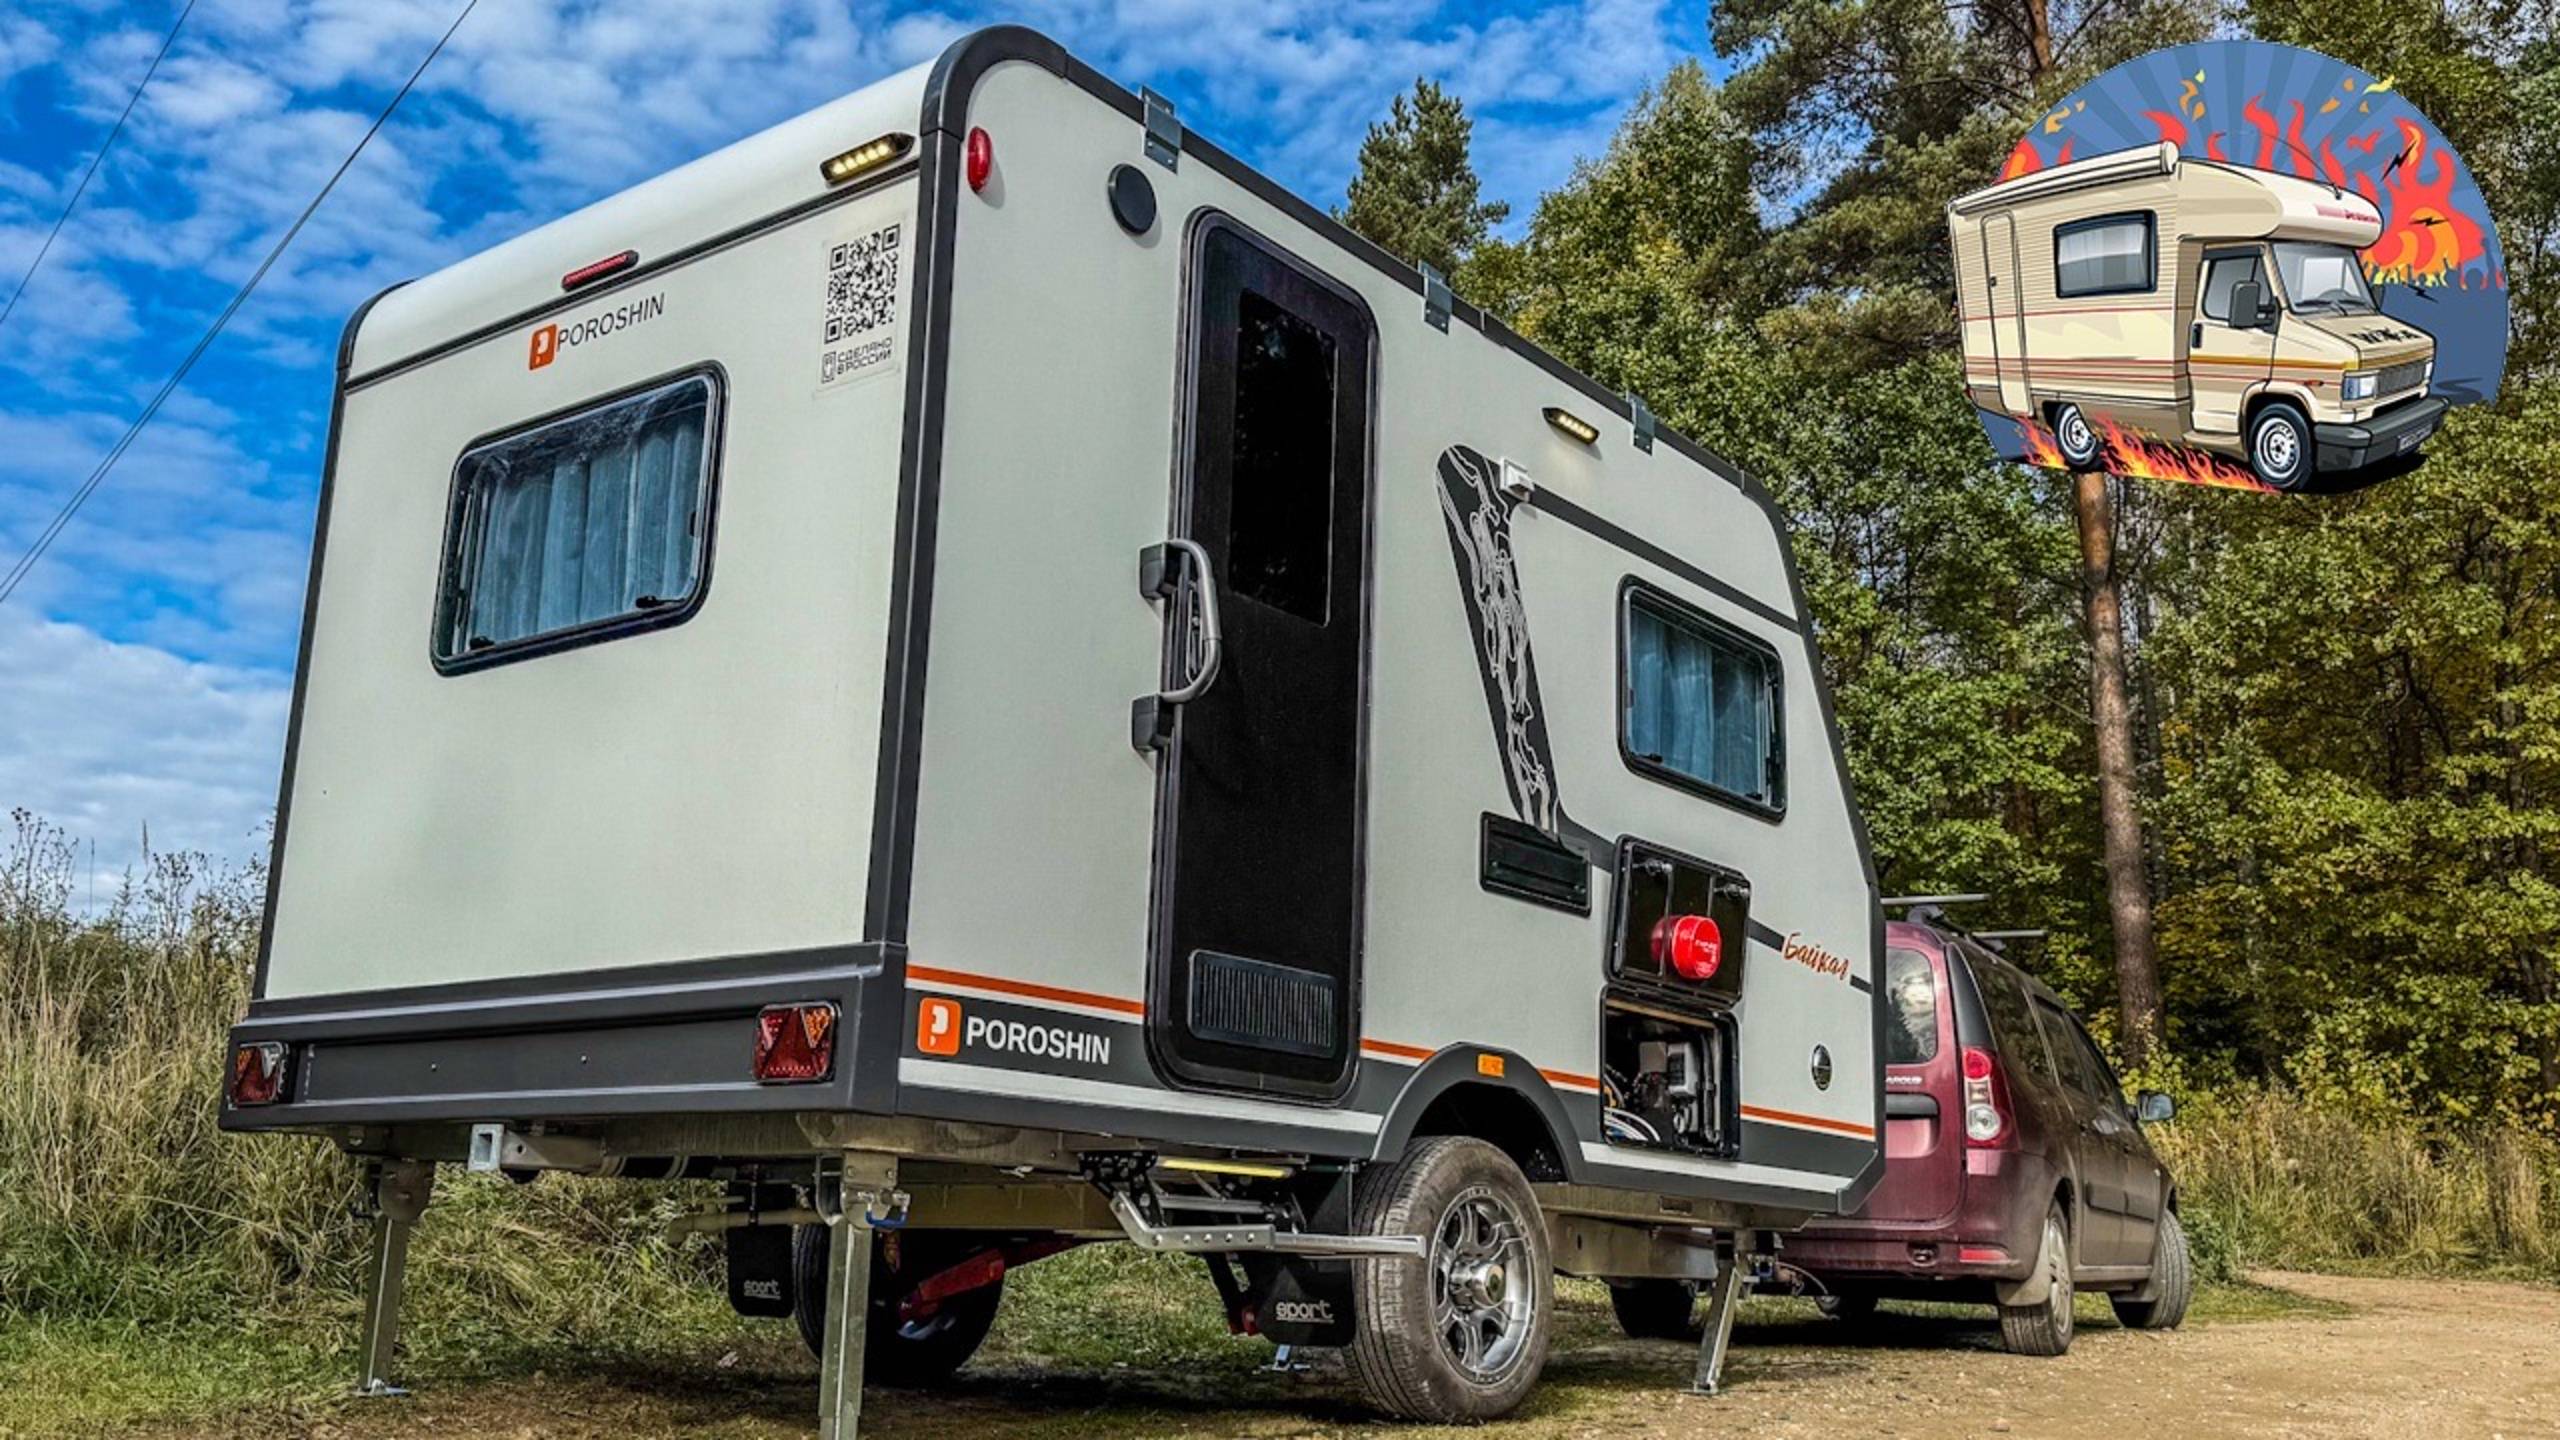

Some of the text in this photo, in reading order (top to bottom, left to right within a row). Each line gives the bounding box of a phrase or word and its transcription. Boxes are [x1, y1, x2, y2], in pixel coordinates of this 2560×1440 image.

[557, 291, 665, 352] POROSHIN
[1784, 931, 1849, 981] Байкал
[966, 1015, 1110, 1065] POROSHIN
[743, 1279, 781, 1297] sport
[1275, 1299, 1334, 1321] sport
